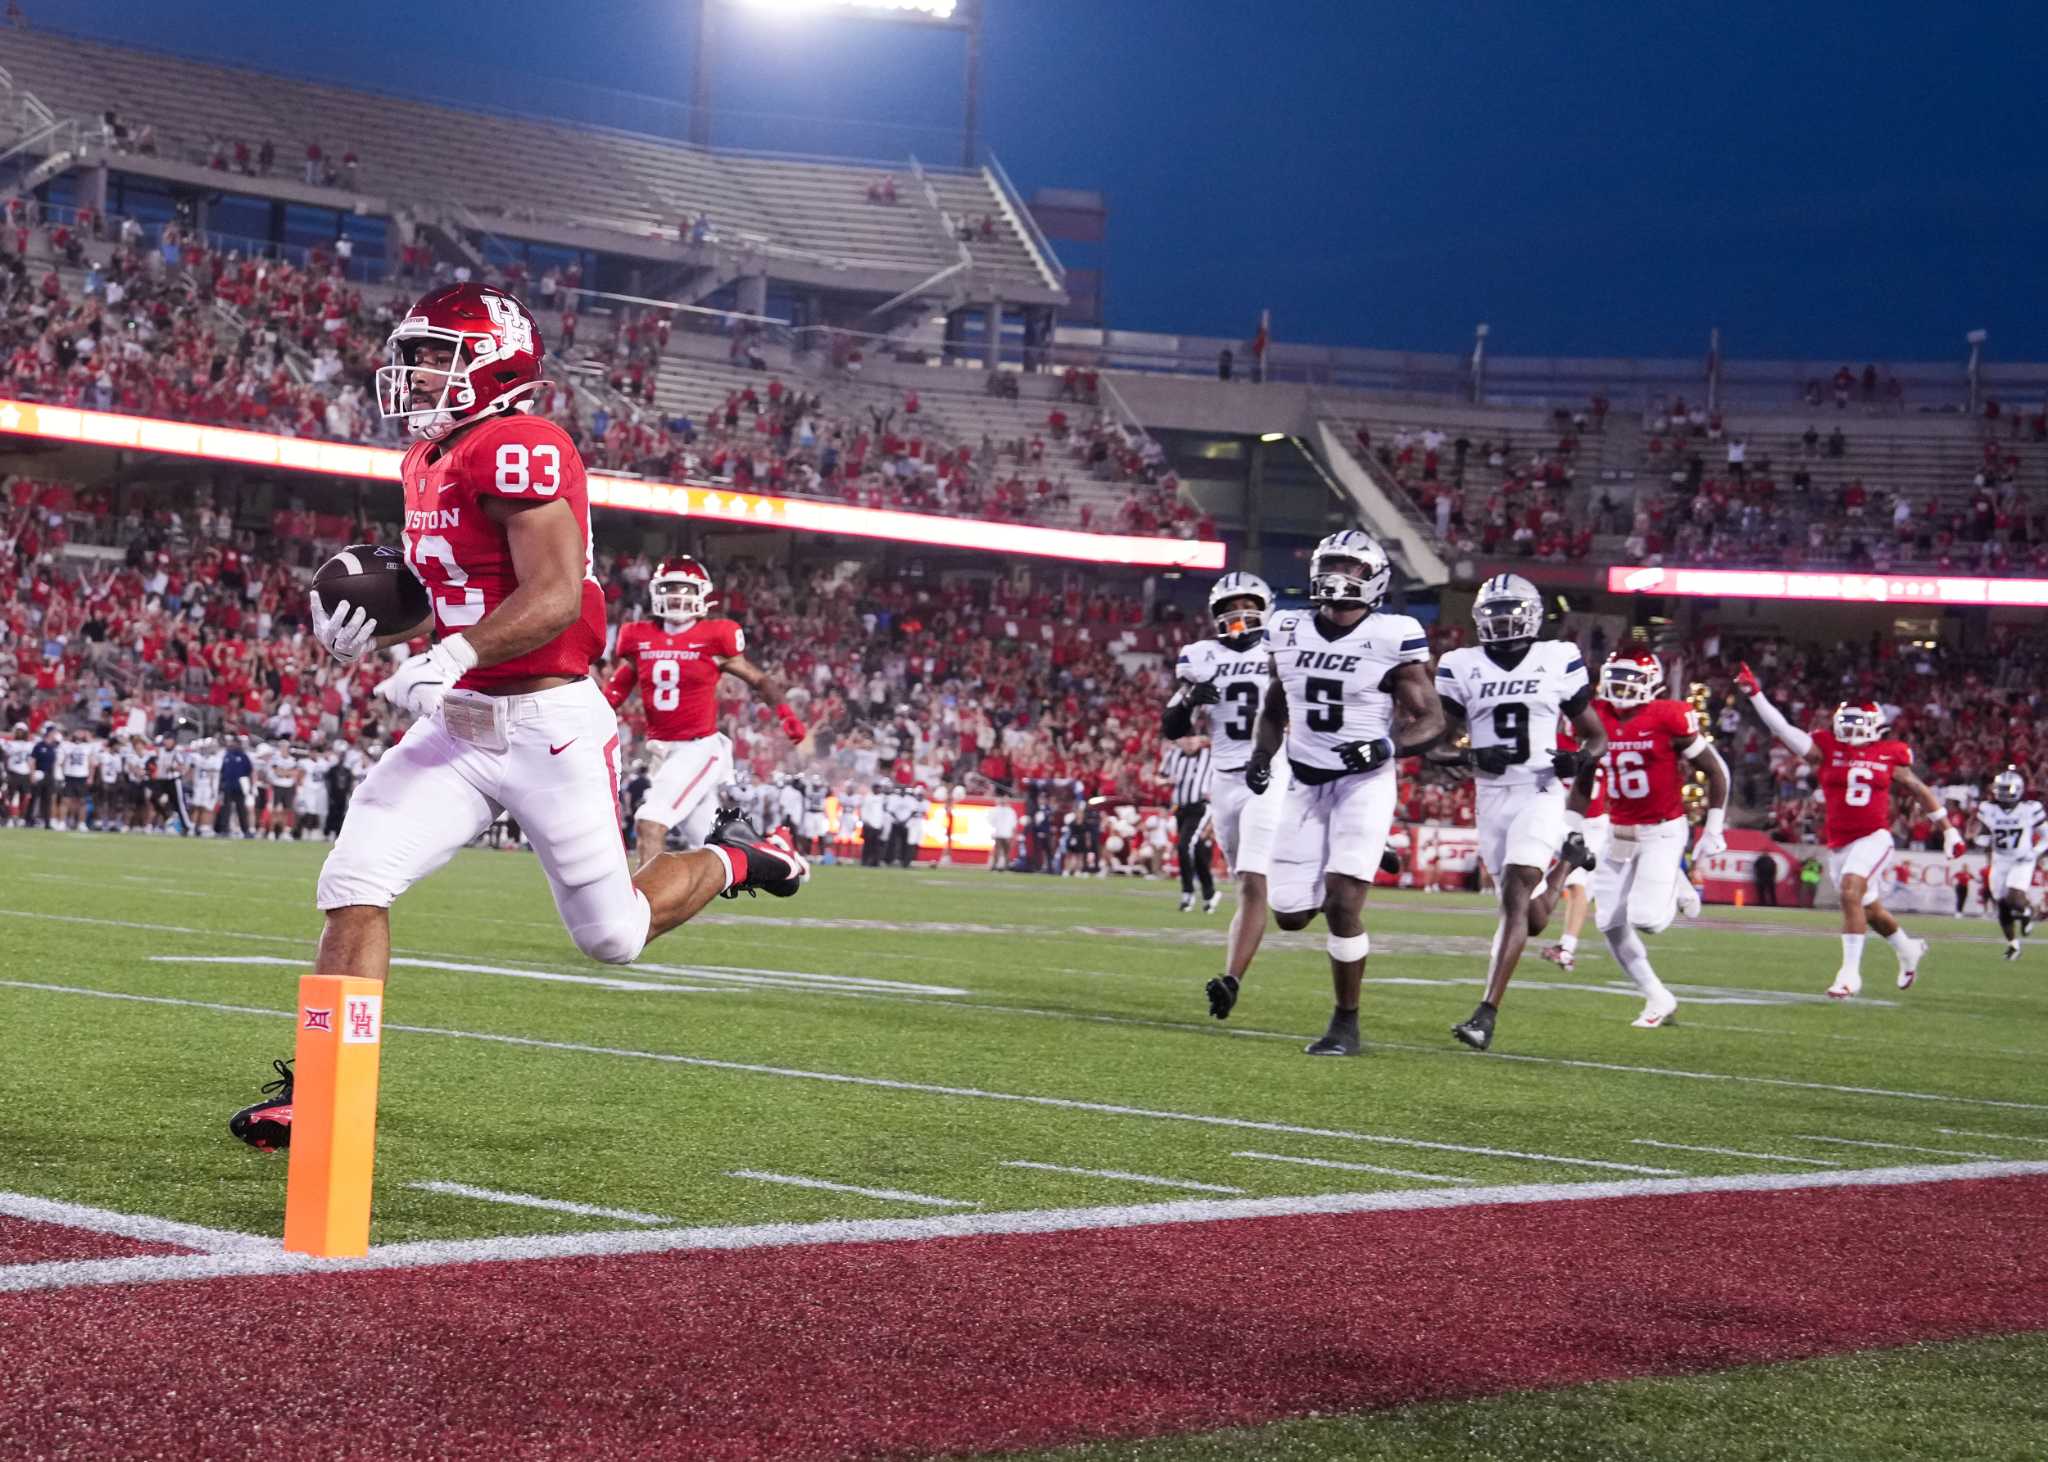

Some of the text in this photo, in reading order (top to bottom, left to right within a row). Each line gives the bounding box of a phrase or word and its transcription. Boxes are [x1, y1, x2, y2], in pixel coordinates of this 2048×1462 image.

[495, 444, 561, 496] 83
[652, 660, 680, 711] 8
[1215, 662, 1270, 677] RICE
[1295, 651, 1361, 673] RICE
[1225, 682, 1260, 740] 3
[1305, 677, 1344, 733] 5
[1480, 680, 1540, 699] RICE
[1493, 702, 1530, 764] 9
[1600, 751, 1650, 799] 16
[1845, 767, 1874, 807] 6
[1994, 828, 2024, 849] 27
